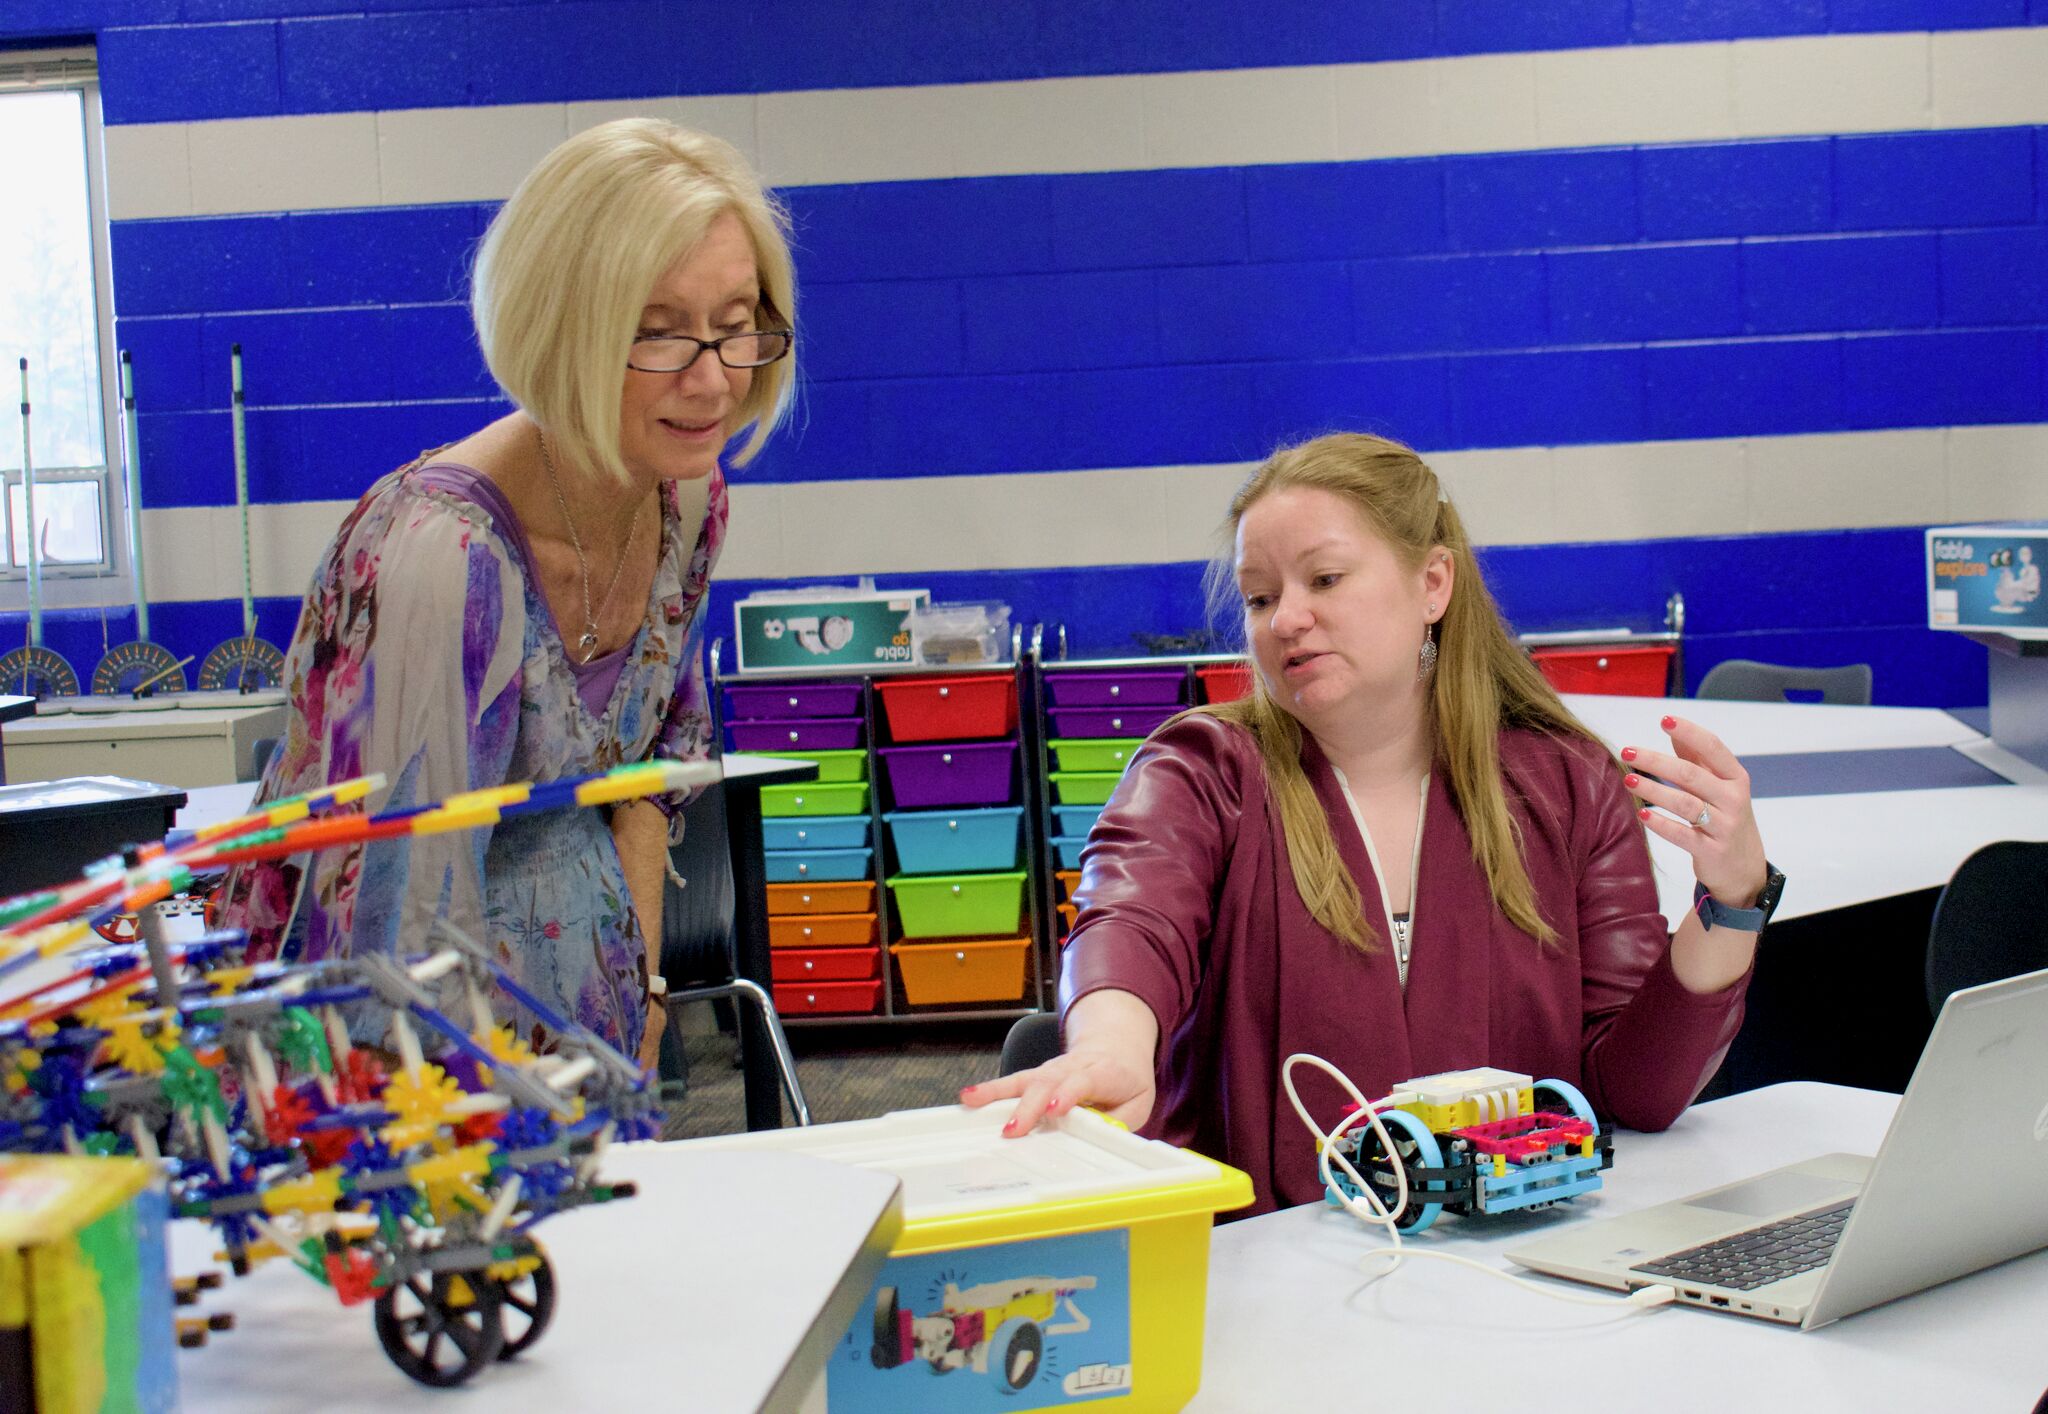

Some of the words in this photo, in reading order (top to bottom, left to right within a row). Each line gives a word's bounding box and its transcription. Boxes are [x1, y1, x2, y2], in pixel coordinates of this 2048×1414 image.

[1936, 541, 1973, 560] fable
[1936, 562, 1987, 580] explore
[892, 632, 909, 645] go
[875, 647, 910, 660] fable
